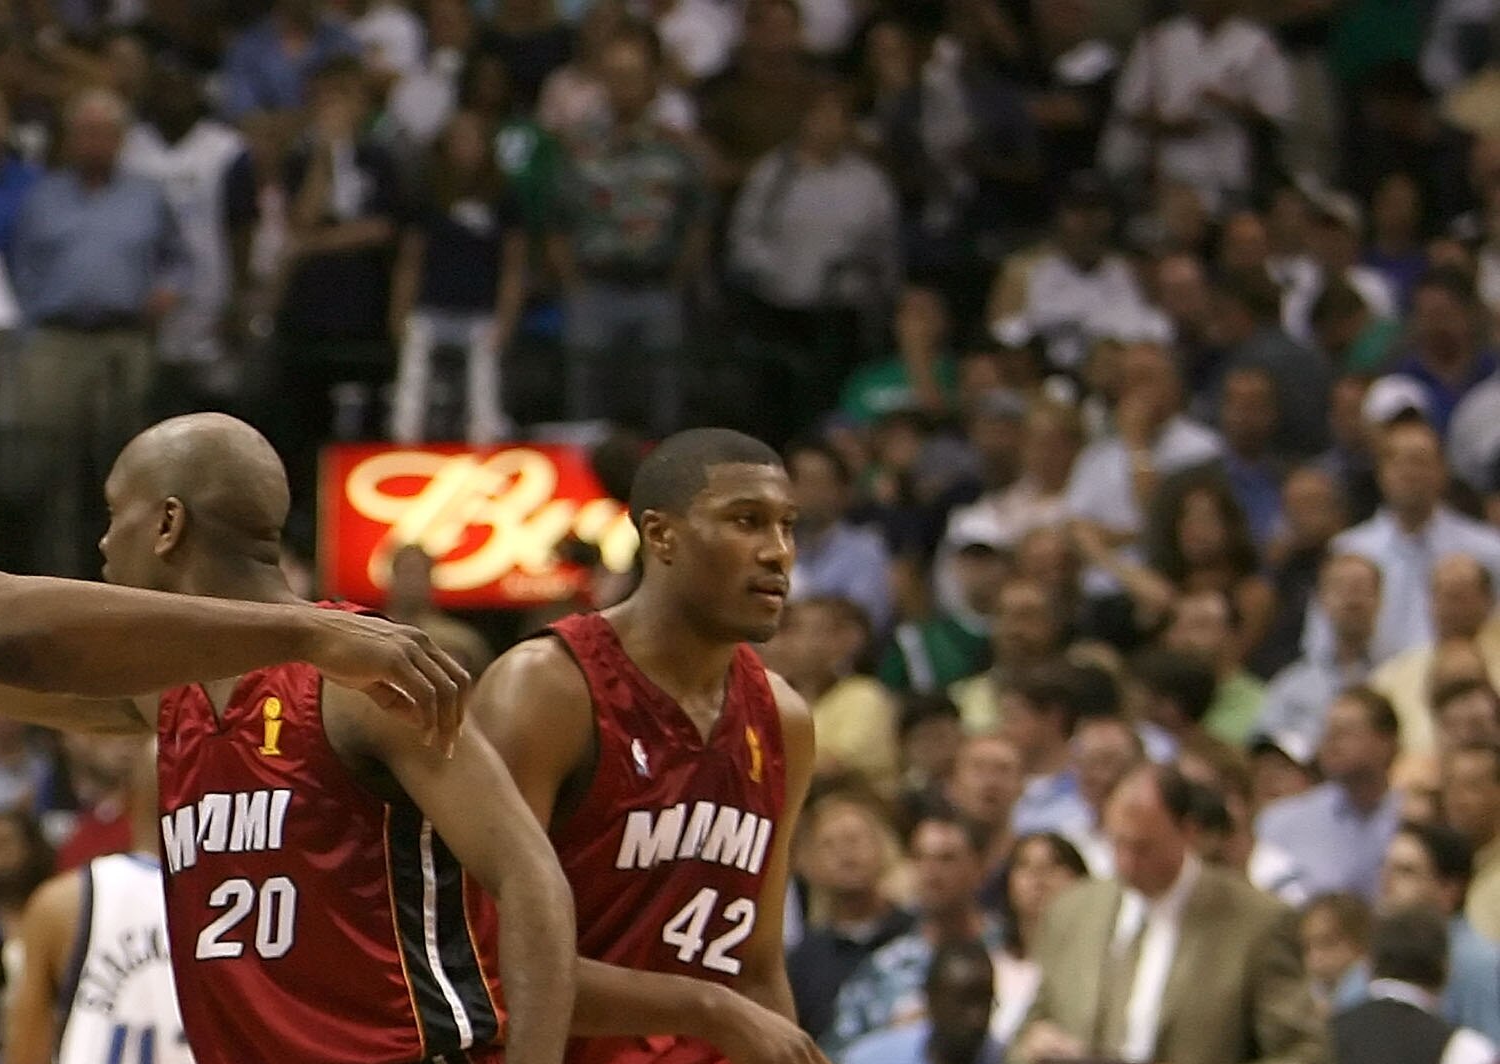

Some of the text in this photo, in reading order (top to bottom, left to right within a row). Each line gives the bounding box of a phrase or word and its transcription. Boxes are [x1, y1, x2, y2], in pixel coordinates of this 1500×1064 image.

[161, 789, 291, 875] MAMI
[615, 801, 772, 875] MIAMI
[195, 876, 296, 960] 20
[662, 887, 756, 976] 42
